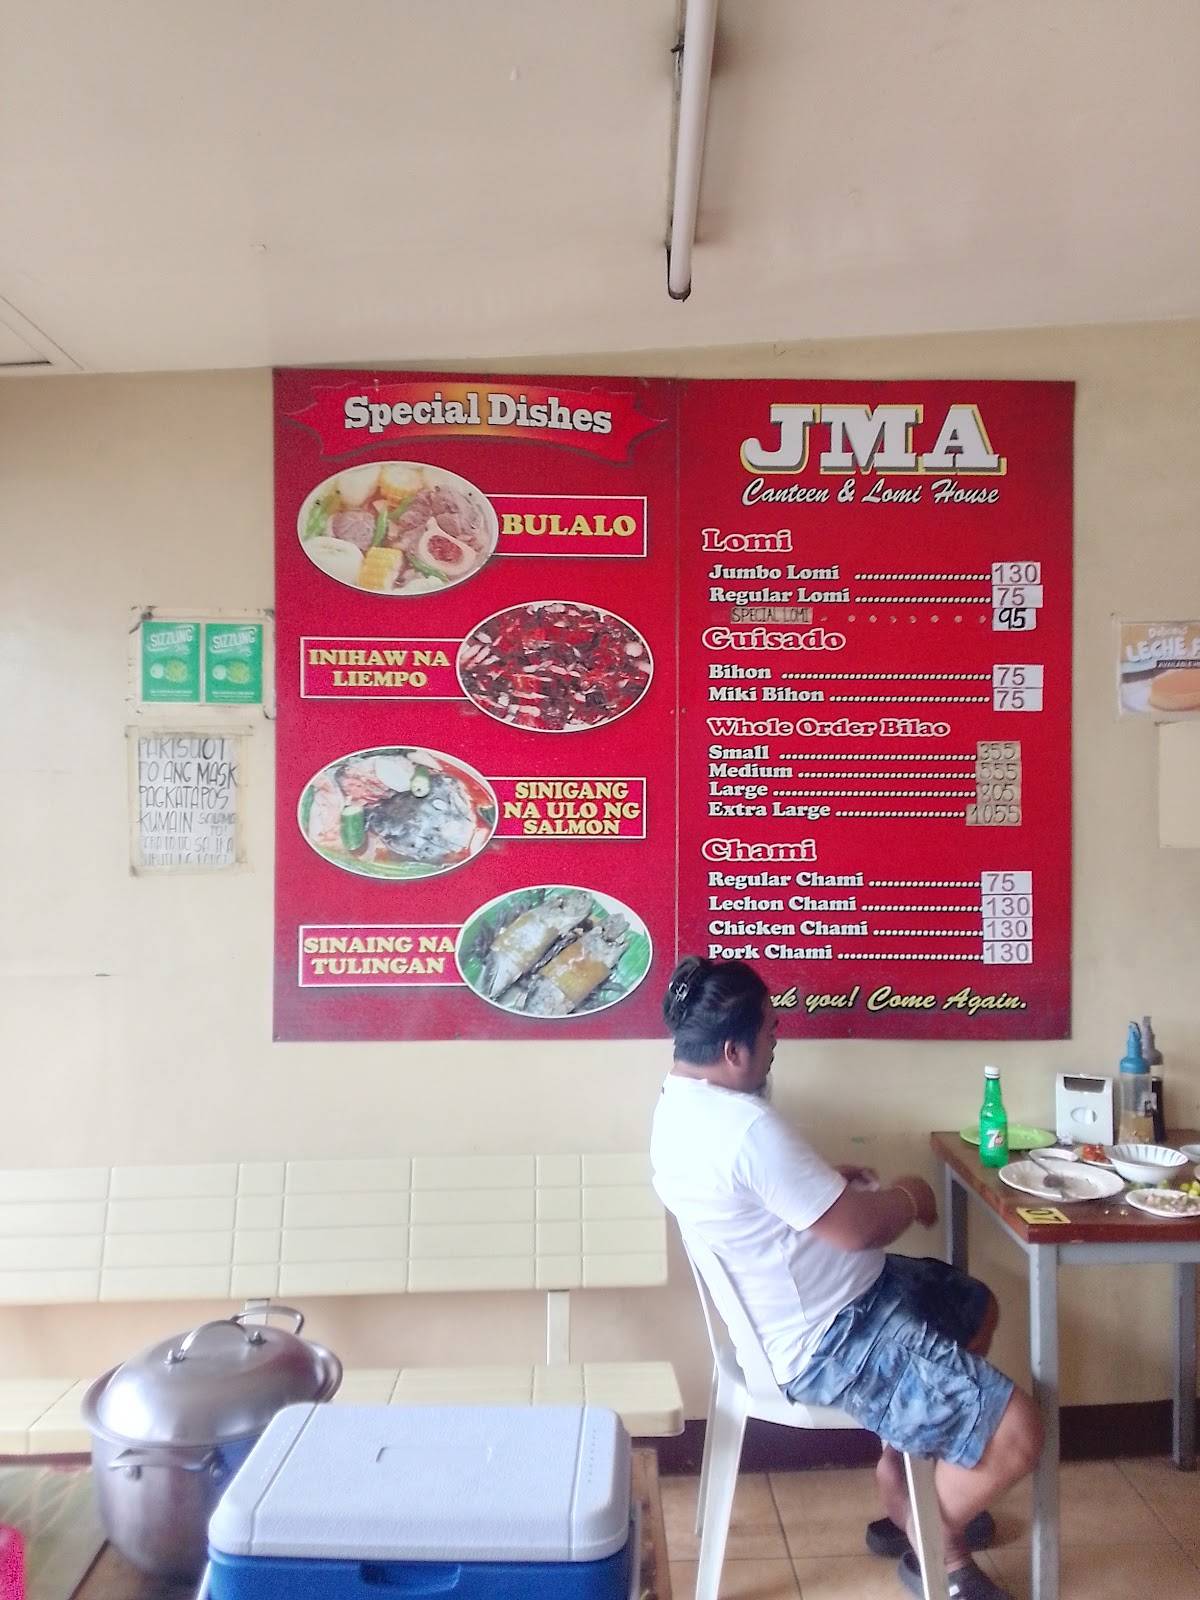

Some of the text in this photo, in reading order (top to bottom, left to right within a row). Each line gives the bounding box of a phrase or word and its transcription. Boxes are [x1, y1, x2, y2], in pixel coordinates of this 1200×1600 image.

[343, 392, 612, 435] Special Dishes
[741, 403, 1007, 476] JMA
[742, 478, 1000, 506] Canteen & Lomi House
[501, 514, 636, 537] BULALO
[701, 528, 792, 552] Lomi
[708, 565, 840, 580] Jumbo Lomi
[995, 564, 1038, 583] 130
[708, 587, 850, 606] Regular Lomi
[998, 588, 1025, 606] 75
[732, 607, 780, 623] SPECIAL
[998, 609, 1026, 630] 95
[702, 627, 846, 651] Guisado
[309, 649, 450, 667] INIHAW NA
[1125, 637, 1186, 662] LECHE
[332, 671, 428, 688] LIEMPO
[708, 664, 772, 680] Bihon
[998, 667, 1025, 685] 75
[708, 687, 825, 702] Miki Bihon
[998, 690, 1025, 709] 75
[707, 717, 950, 737] Whole Order Bilao
[708, 745, 770, 760] Small
[164, 761, 191, 784] ANG
[196, 761, 239, 789] MASK
[708, 764, 793, 779] Medium
[138, 785, 229, 810] PAGKATAPOS
[515, 781, 628, 800] SINIGANG
[708, 782, 768, 800] Large
[503, 801, 641, 819] NA ULO NG
[708, 803, 831, 820] Extra Large
[970, 804, 1020, 824] 1055
[137, 811, 193, 833] KUMAIN
[523, 819, 620, 836] SALMON
[702, 839, 817, 862] Chami
[708, 871, 864, 889] Regular Chami
[987, 873, 1016, 892] 75
[708, 897, 857, 912] Lechon Chami
[986, 897, 1030, 916] 130
[708, 921, 868, 936] Chicken Chami
[986, 920, 1028, 938] 130
[303, 936, 456, 954] SINAING NA
[708, 945, 833, 960] Pork Chami
[986, 943, 1030, 962] 130
[311, 957, 445, 975] TULINGAN
[805, 986, 859, 1012] you!
[867, 986, 938, 1011] Come
[942, 987, 1028, 1015] Again.
